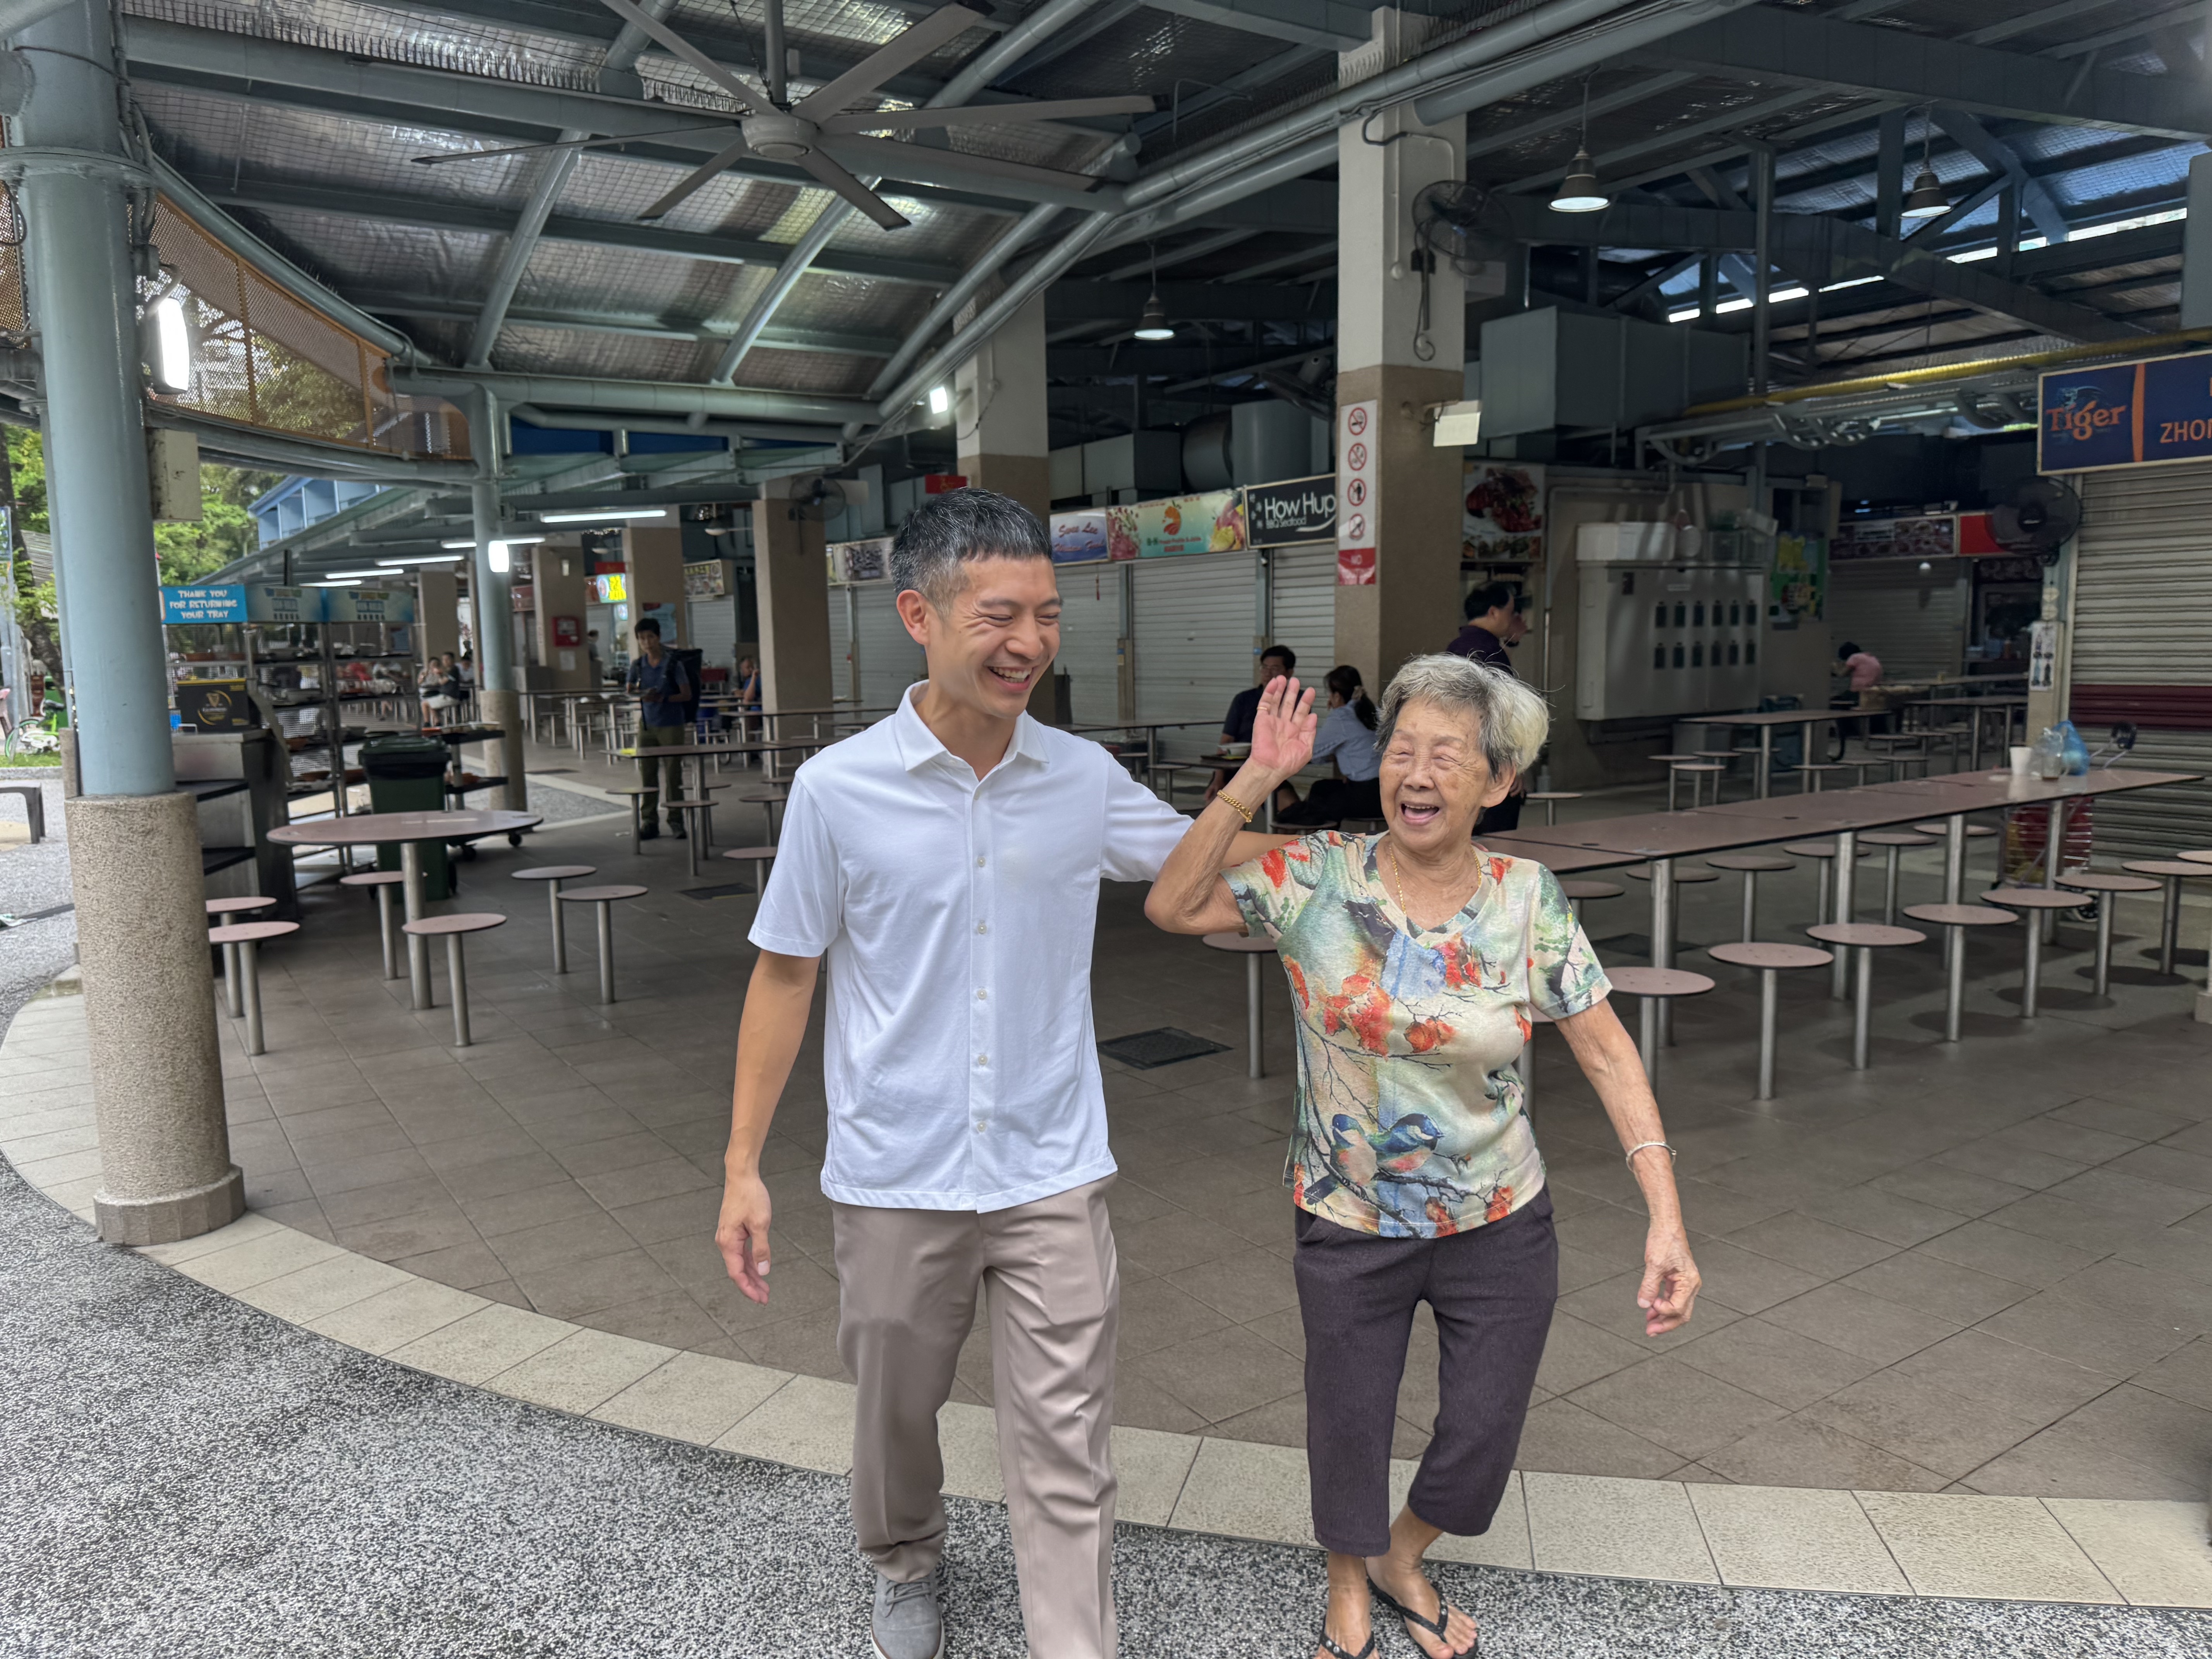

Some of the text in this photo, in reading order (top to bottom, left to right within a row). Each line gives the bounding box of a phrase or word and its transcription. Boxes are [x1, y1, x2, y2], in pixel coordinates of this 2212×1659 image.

[2046, 400, 2126, 441] Tiger
[1265, 497, 1300, 520] How
[1303, 491, 1336, 518] Hup
[178, 590, 207, 598] THANK
[170, 599, 237, 609] FOR RETURNING
[181, 610, 228, 619] YOUR TRAY
